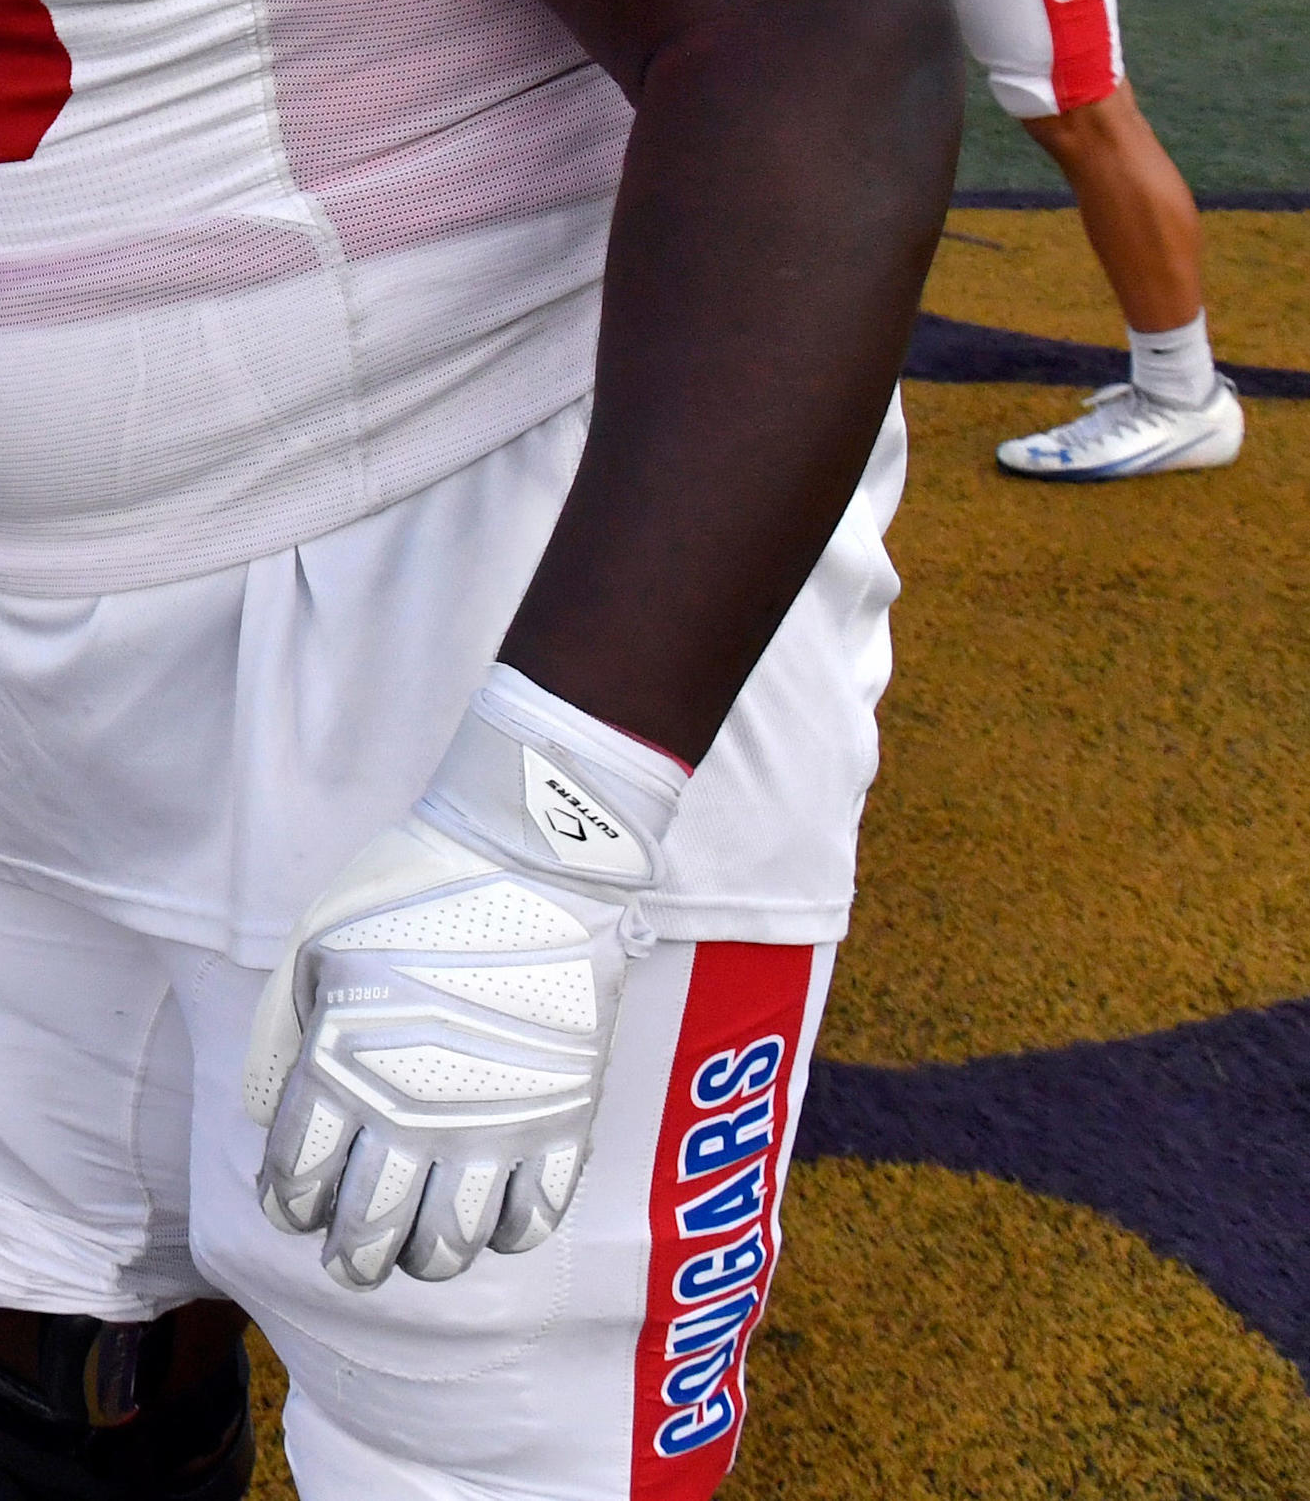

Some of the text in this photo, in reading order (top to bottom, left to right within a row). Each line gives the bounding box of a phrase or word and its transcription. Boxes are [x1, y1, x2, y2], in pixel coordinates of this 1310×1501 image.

[545, 779, 620, 840] CUTTERS
[348, 986, 389, 1001] FORCE
[654, 1034, 785, 1457] COUGARS
